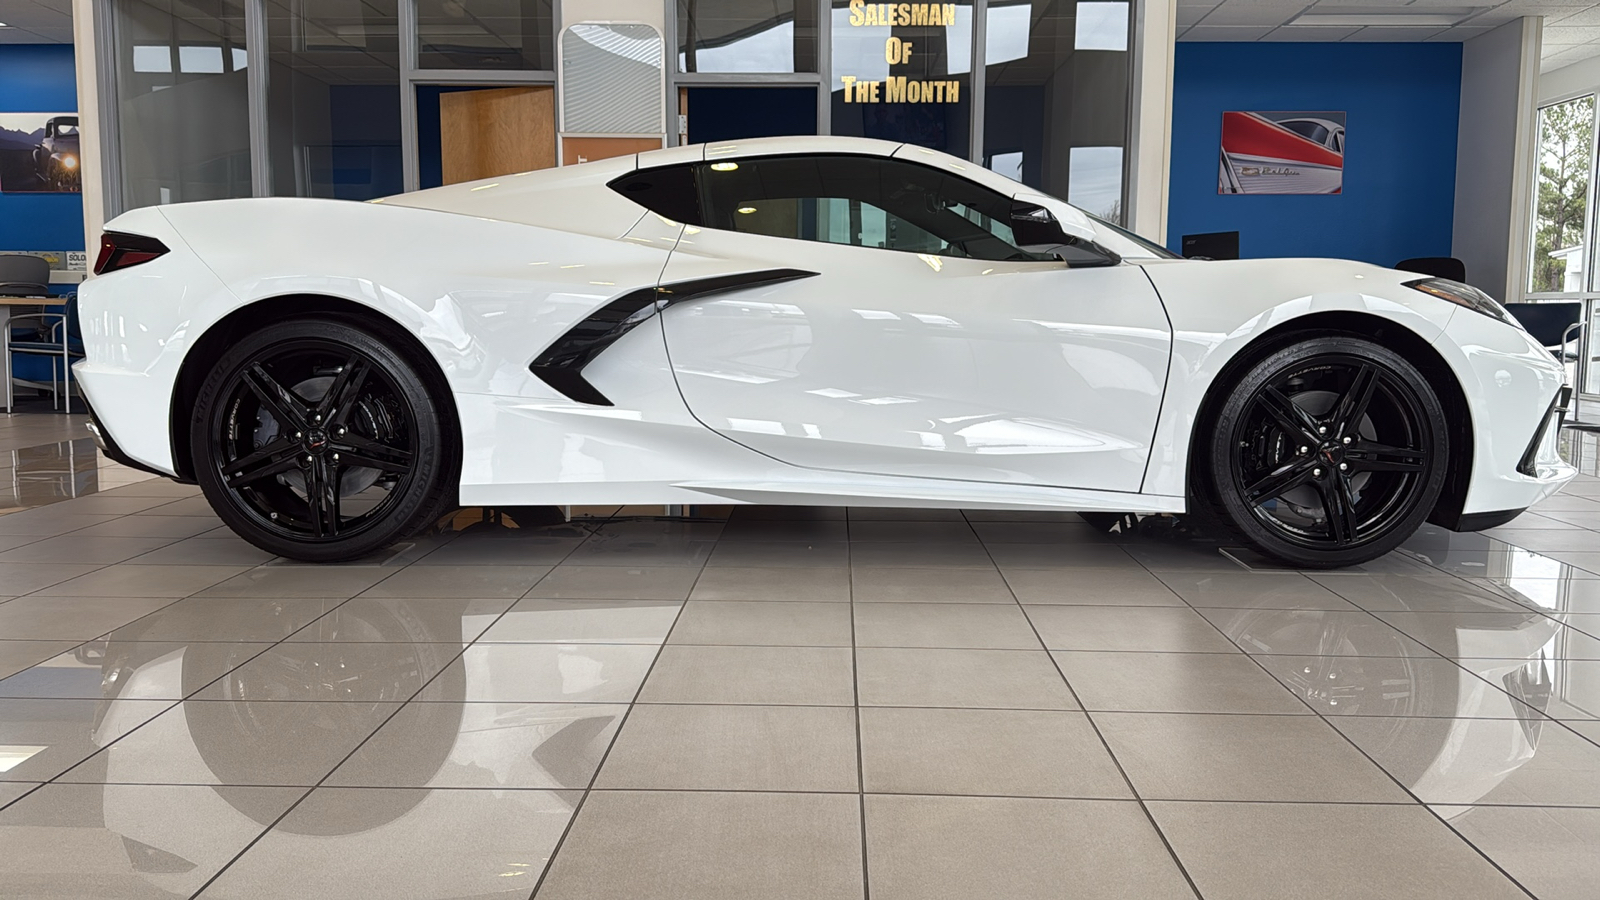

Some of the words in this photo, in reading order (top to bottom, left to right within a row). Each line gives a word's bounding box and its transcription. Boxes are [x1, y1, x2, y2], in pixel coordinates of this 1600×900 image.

[849, 0, 955, 26] SALESMAN
[885, 37, 913, 64] OF
[841, 75, 880, 103] THE
[885, 76, 960, 103] MONTH
